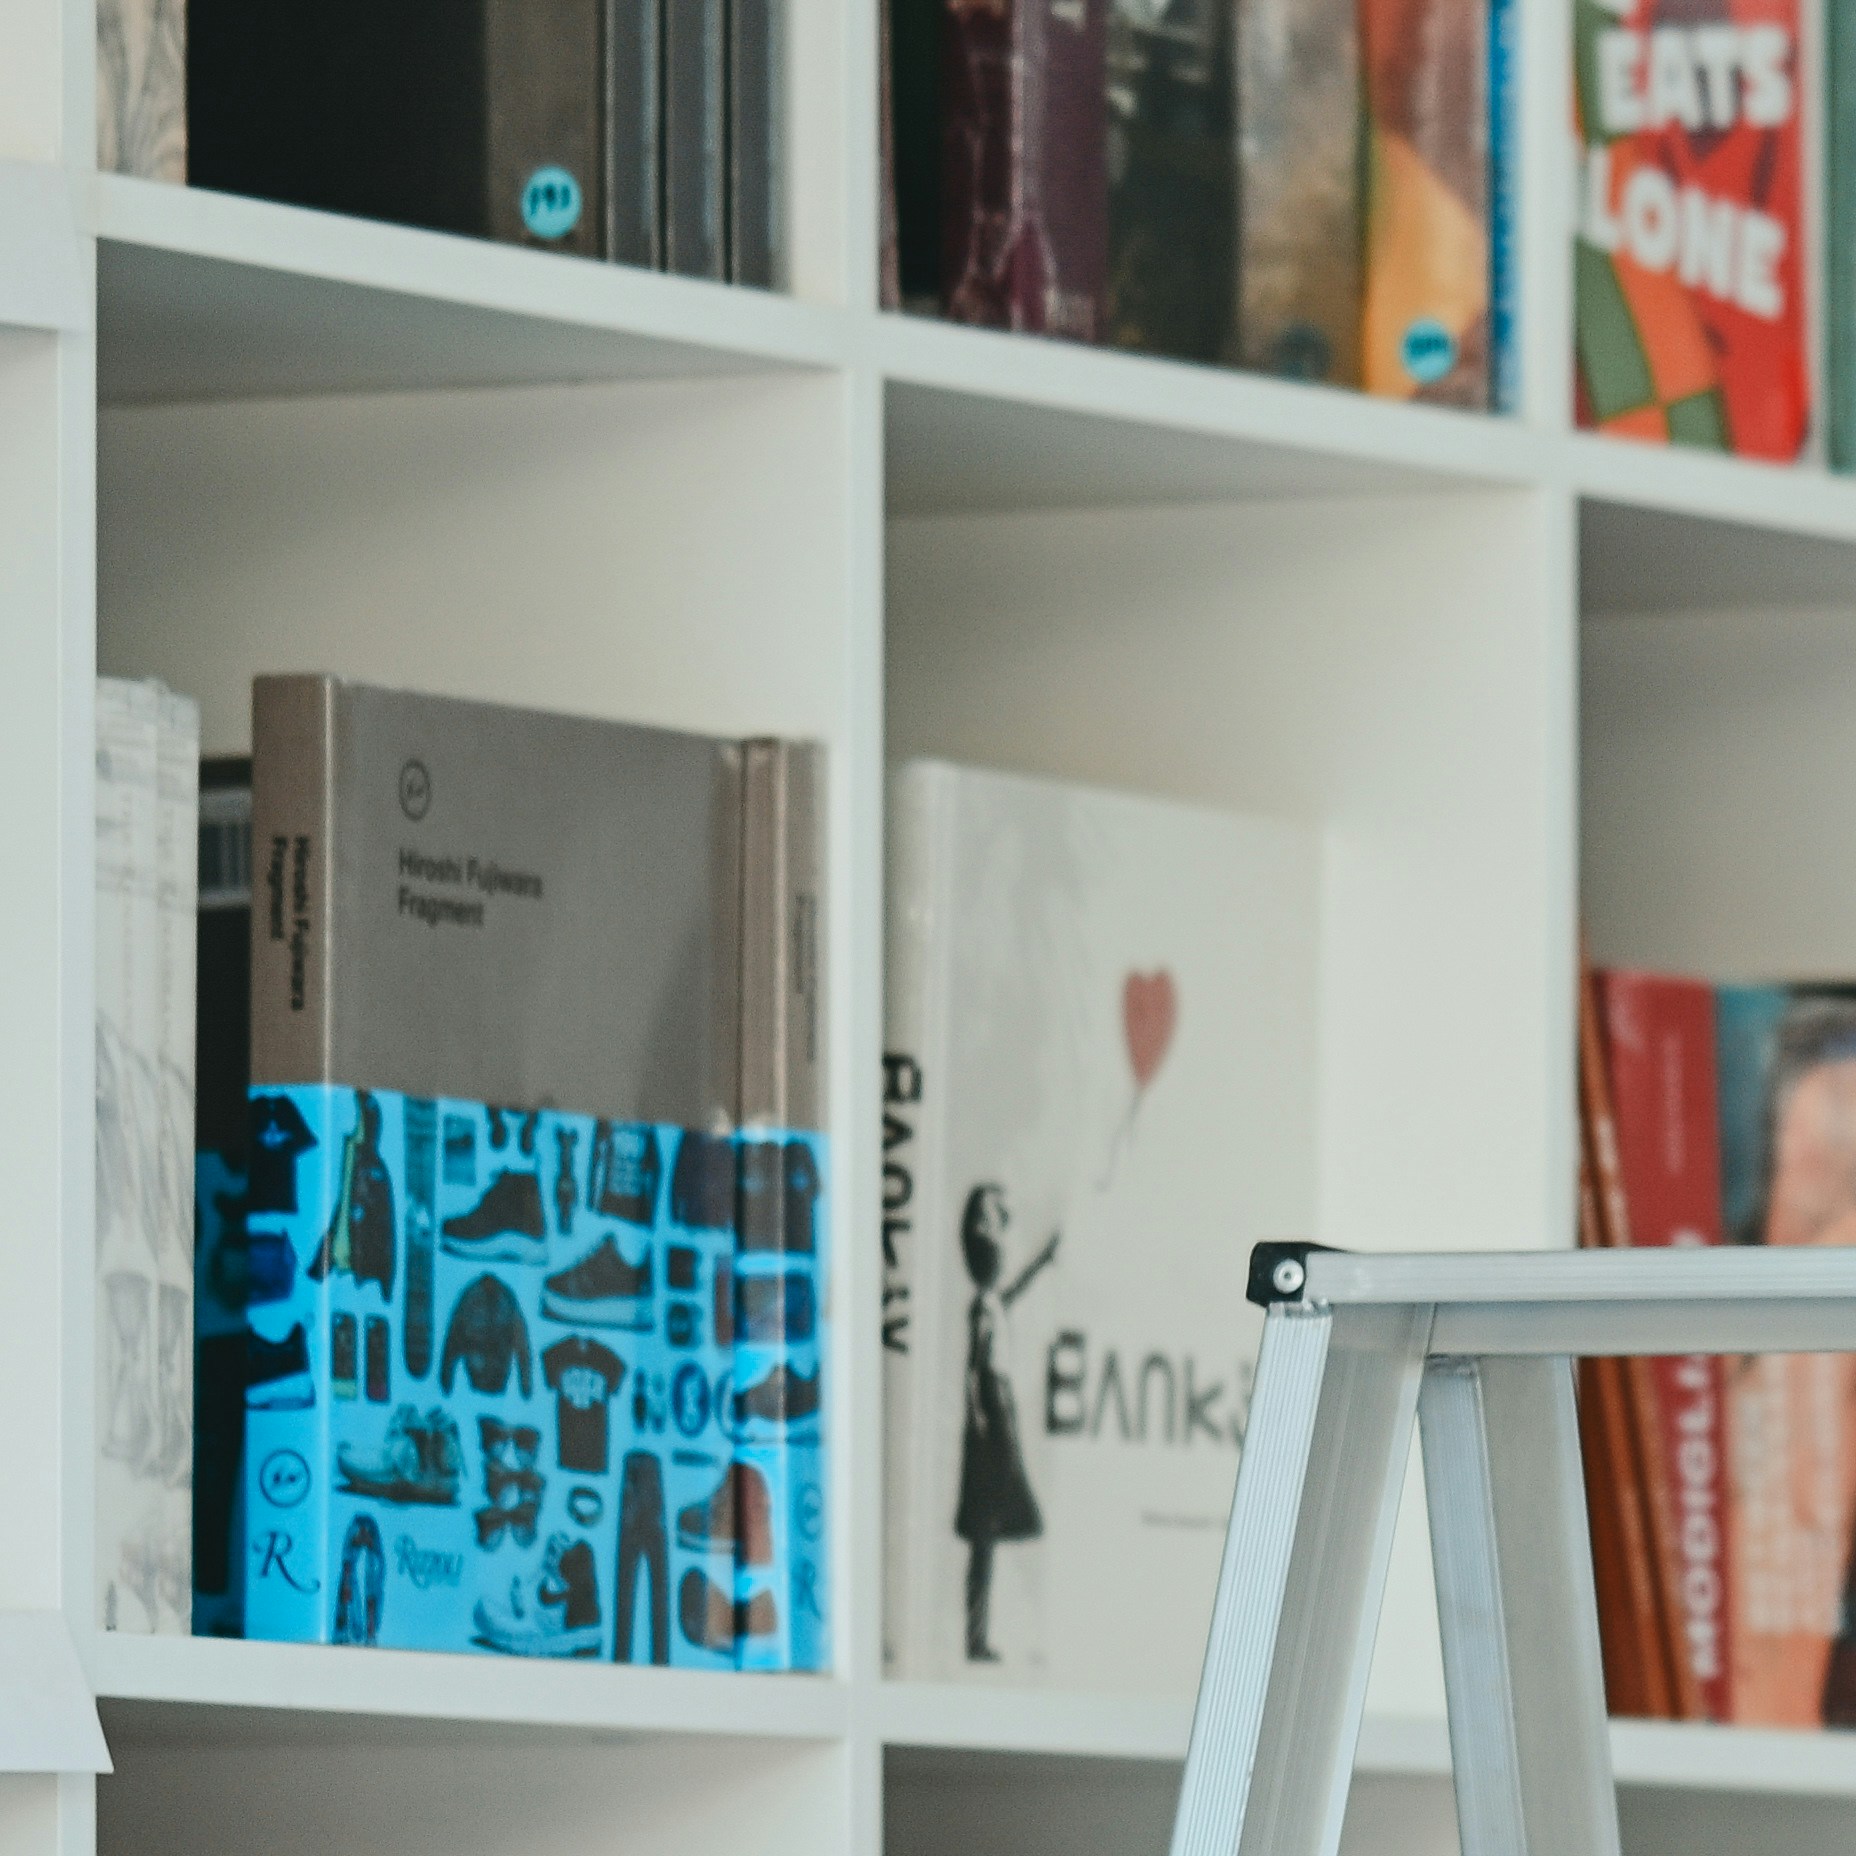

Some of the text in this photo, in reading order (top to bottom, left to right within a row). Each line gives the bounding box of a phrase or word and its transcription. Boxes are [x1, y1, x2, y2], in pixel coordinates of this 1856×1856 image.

[1598, 24, 1793, 136] EATS
[268, 836, 290, 940] Fragment
[399, 847, 544, 898] Hiroshi Fujiwara
[399, 884, 484, 927] Fragment
